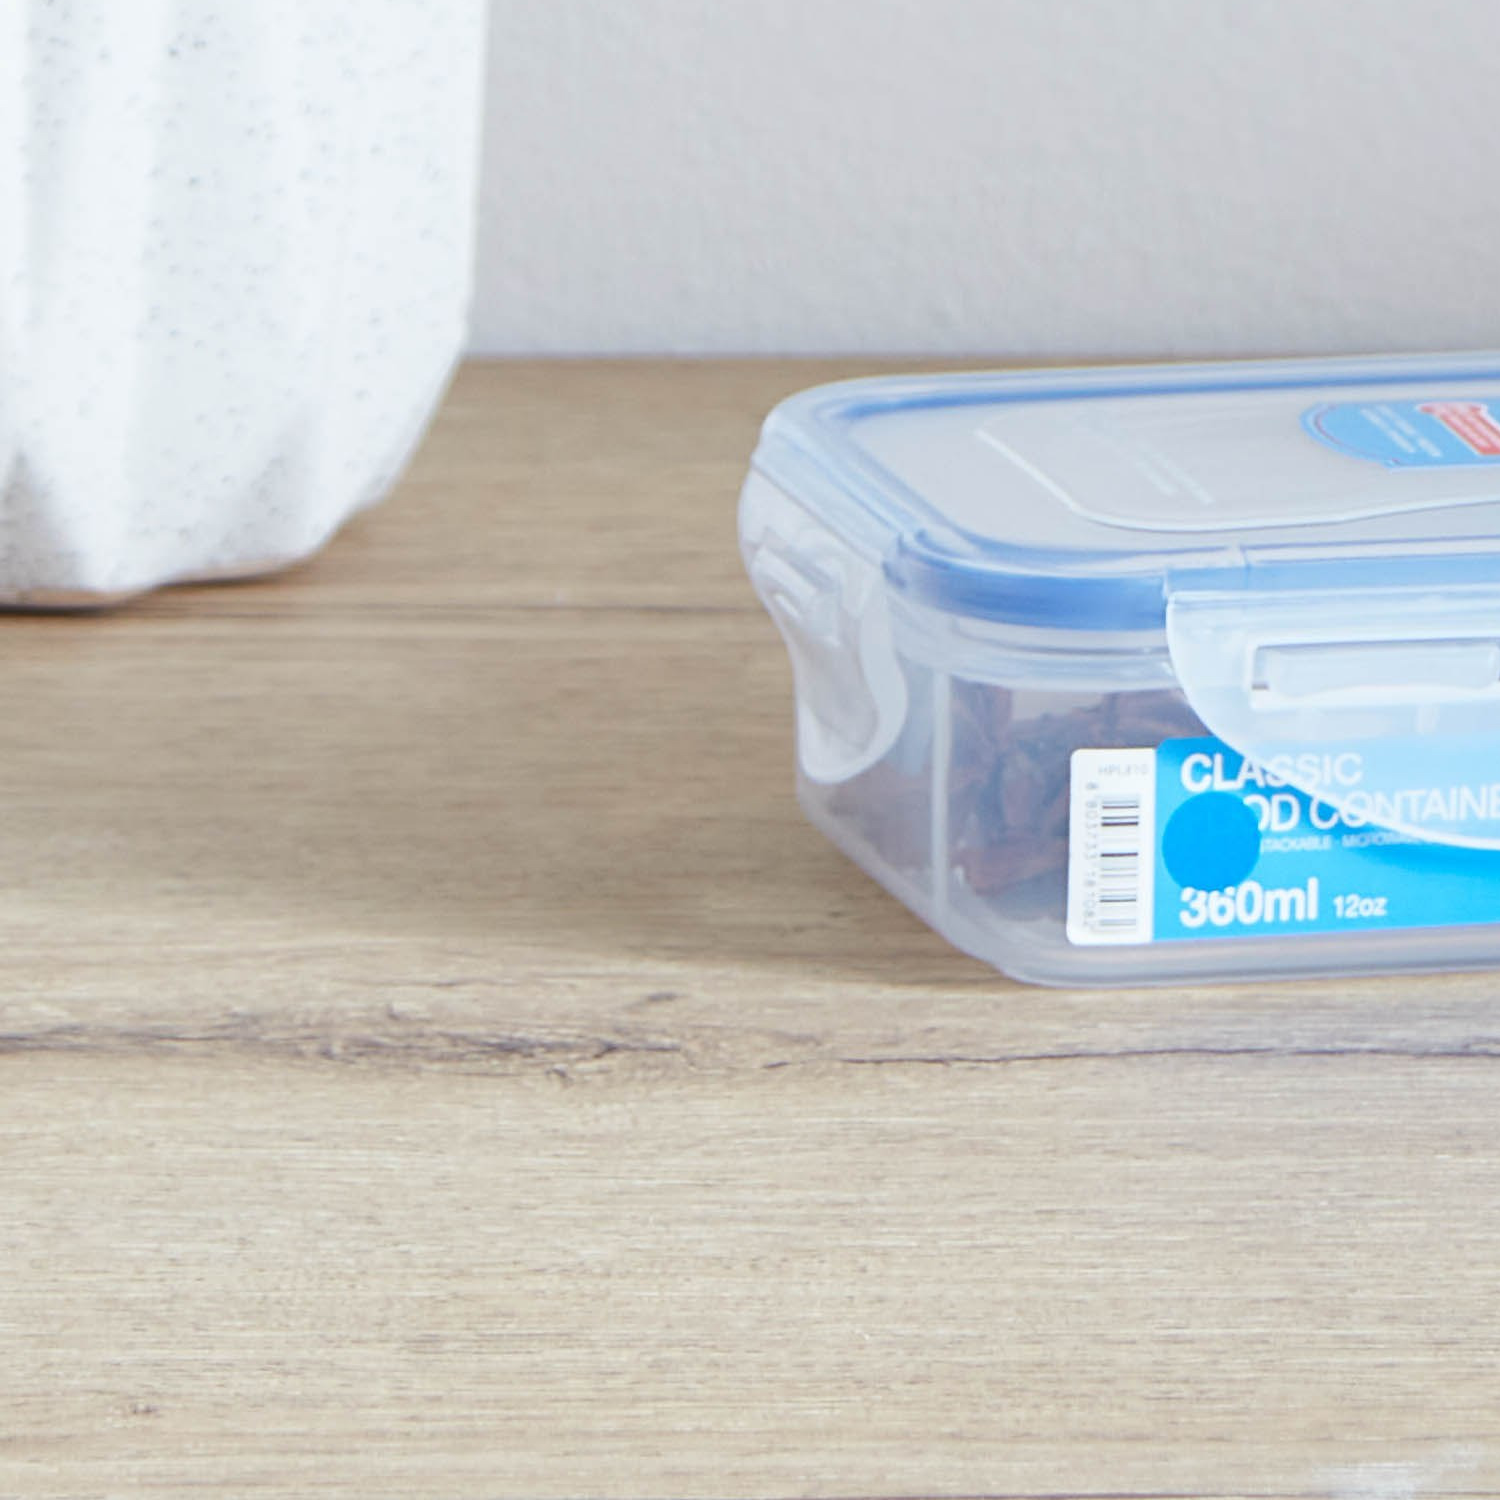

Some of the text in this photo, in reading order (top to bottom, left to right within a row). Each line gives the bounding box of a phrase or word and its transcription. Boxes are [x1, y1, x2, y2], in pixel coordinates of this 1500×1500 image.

[1180, 753, 1363, 793] CLASSIC
[1179, 876, 1388, 928] 360ml 12oz
